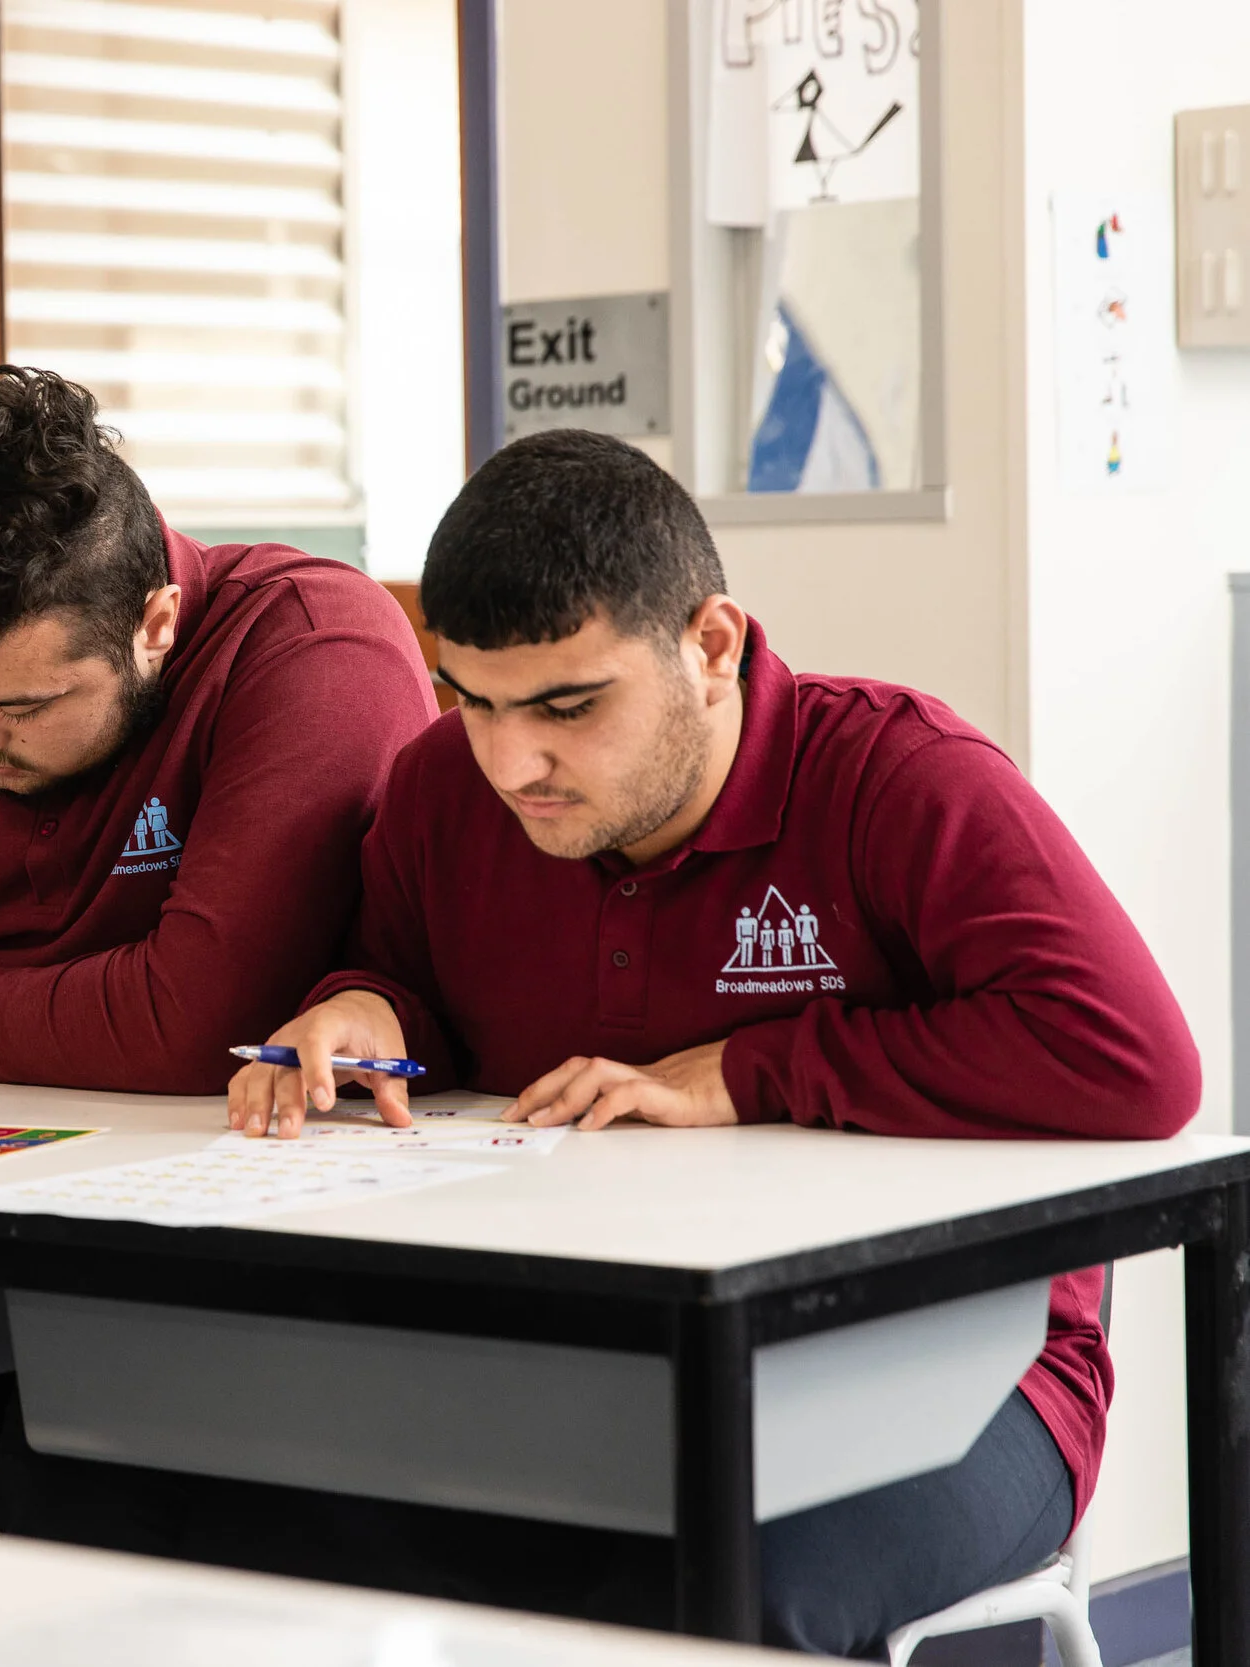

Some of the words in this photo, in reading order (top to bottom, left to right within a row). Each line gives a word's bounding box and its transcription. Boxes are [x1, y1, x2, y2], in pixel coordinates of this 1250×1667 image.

[508, 316, 596, 367] Exit
[507, 371, 626, 412] Ground
[715, 978, 814, 993] Broadmeadows
[819, 975, 846, 990] SDS
